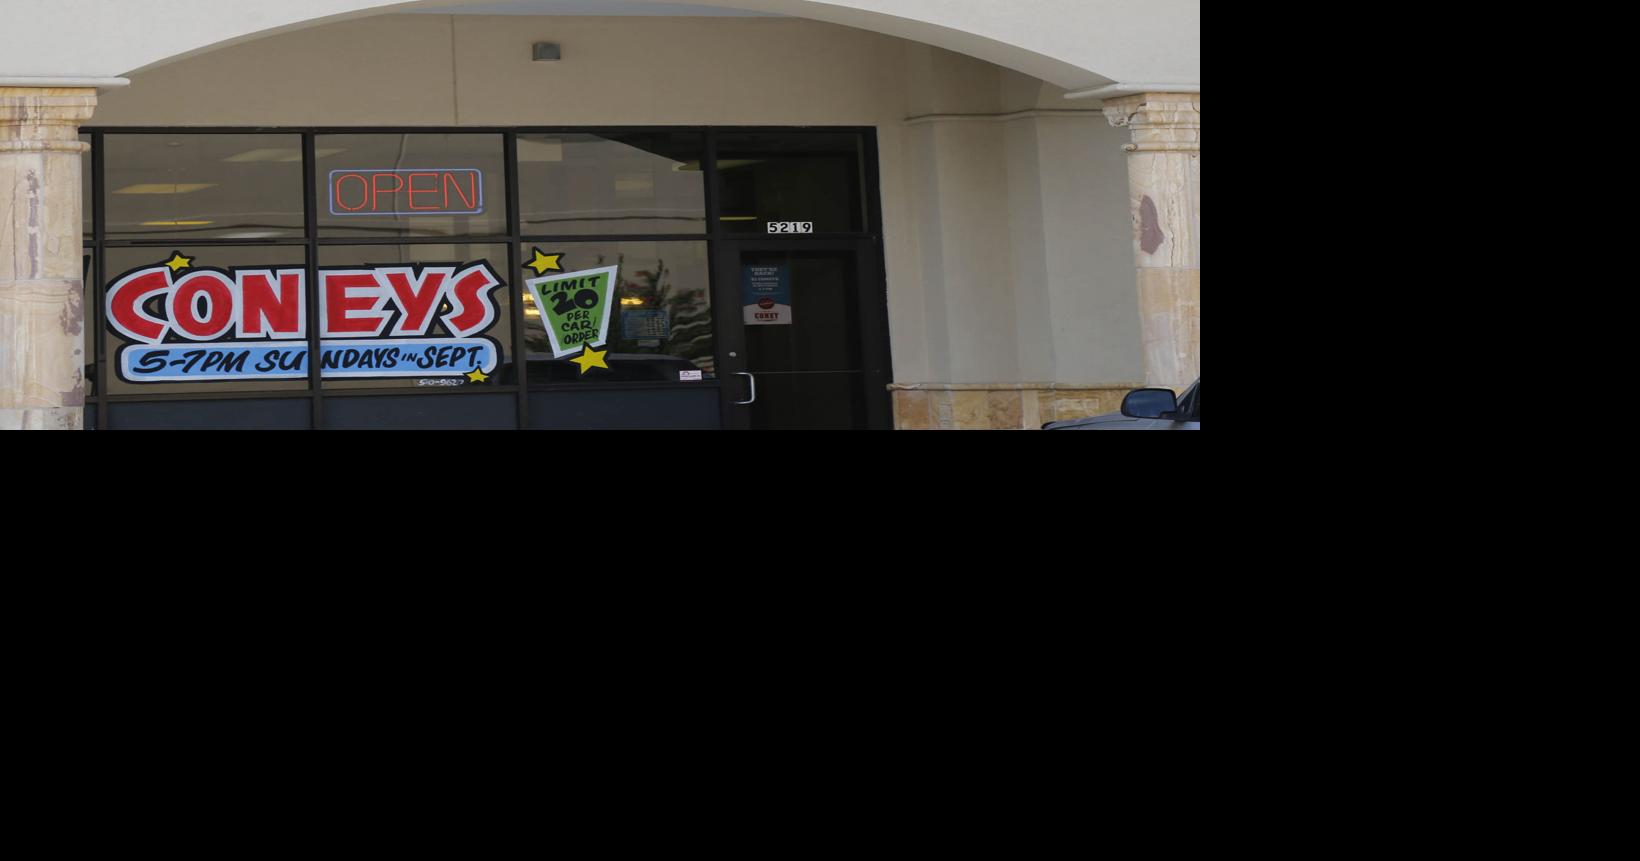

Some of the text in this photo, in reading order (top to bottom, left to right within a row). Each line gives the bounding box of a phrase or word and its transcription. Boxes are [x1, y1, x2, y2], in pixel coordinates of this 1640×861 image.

[335, 172, 478, 211] OPEN
[769, 222, 811, 233] 5219
[541, 276, 601, 296] LIMIT
[107, 266, 498, 343] CONEYS
[550, 288, 599, 316] 20
[566, 310, 590, 321] PER
[563, 328, 599, 345] ORDER
[132, 345, 484, 374] 5-7PM SUNDAYS IN SEPT.
